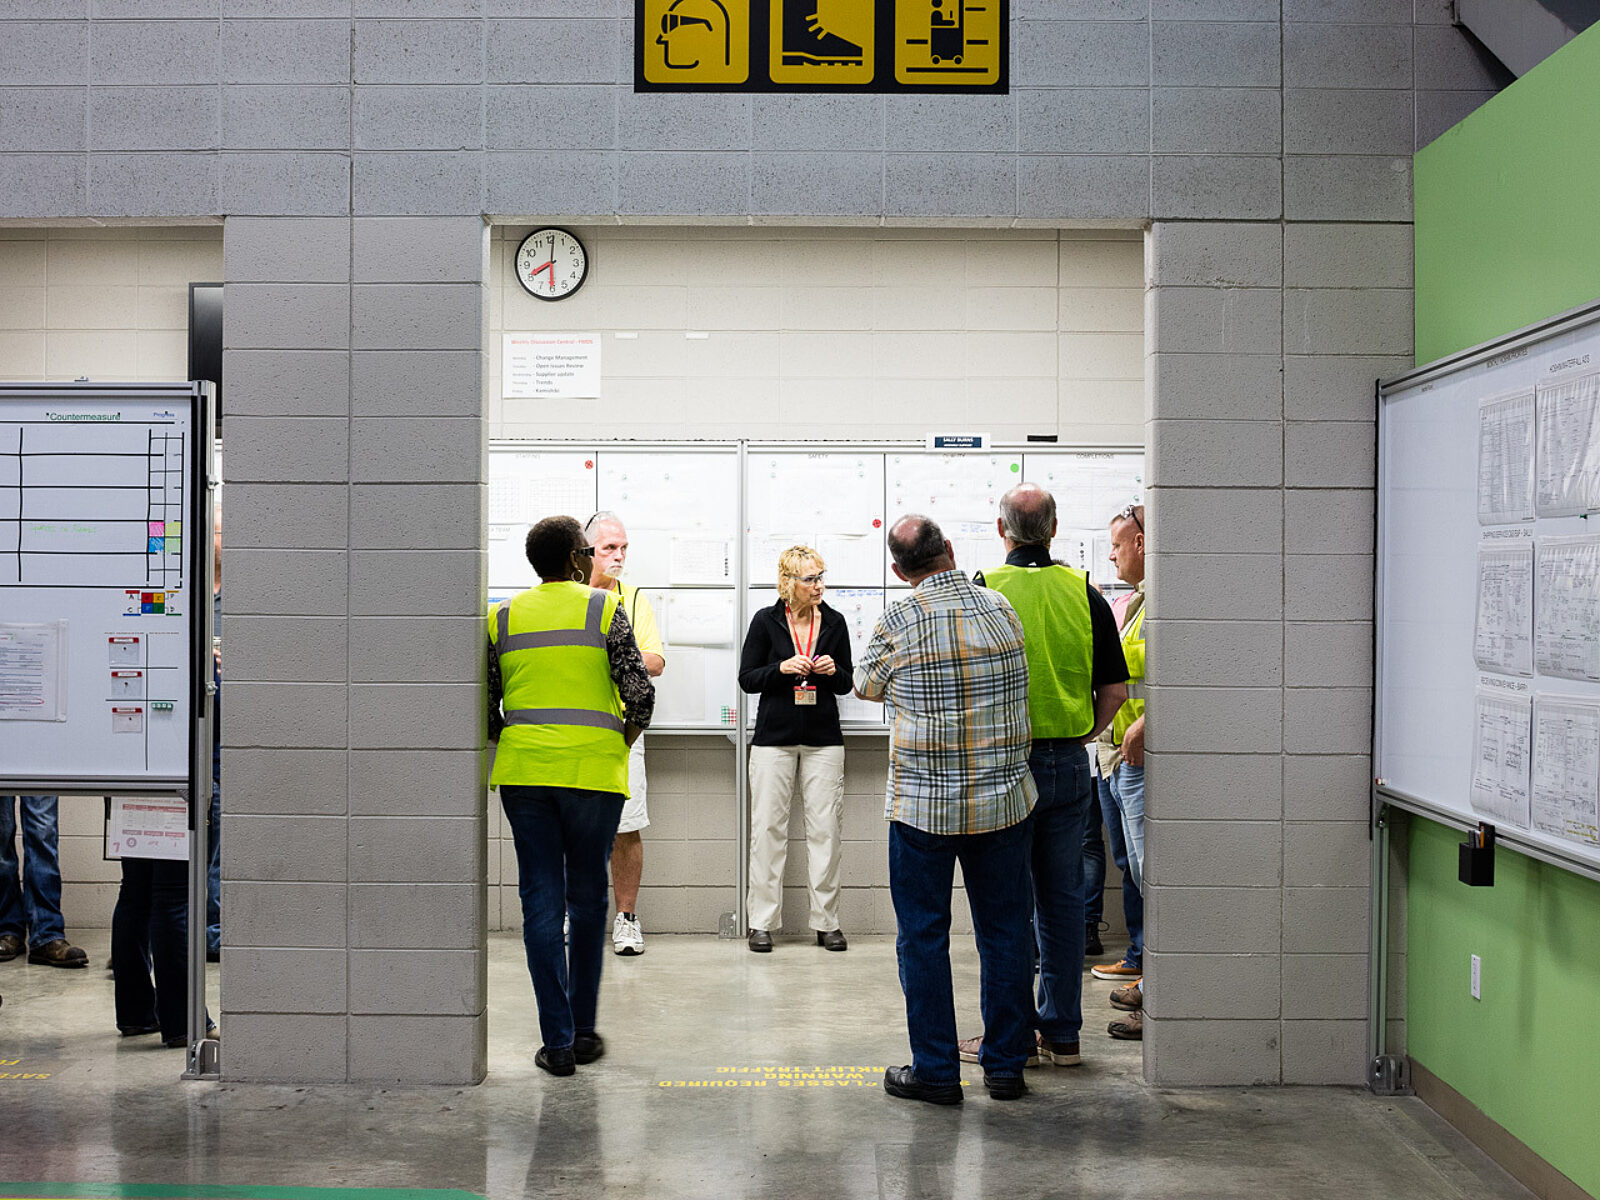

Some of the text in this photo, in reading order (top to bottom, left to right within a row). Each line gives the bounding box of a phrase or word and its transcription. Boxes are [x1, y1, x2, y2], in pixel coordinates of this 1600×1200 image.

[535, 240, 543, 248] 11
[526, 248, 536, 258] 10
[569, 246, 576, 254] 2
[524, 261, 531, 269] 9
[573, 259, 579, 267] 3
[570, 271, 576, 279] 4
[561, 280, 567, 289] 5
[50, 412, 121, 421] Countermeasure
[658, 1079, 766, 1087] REQUIRED
